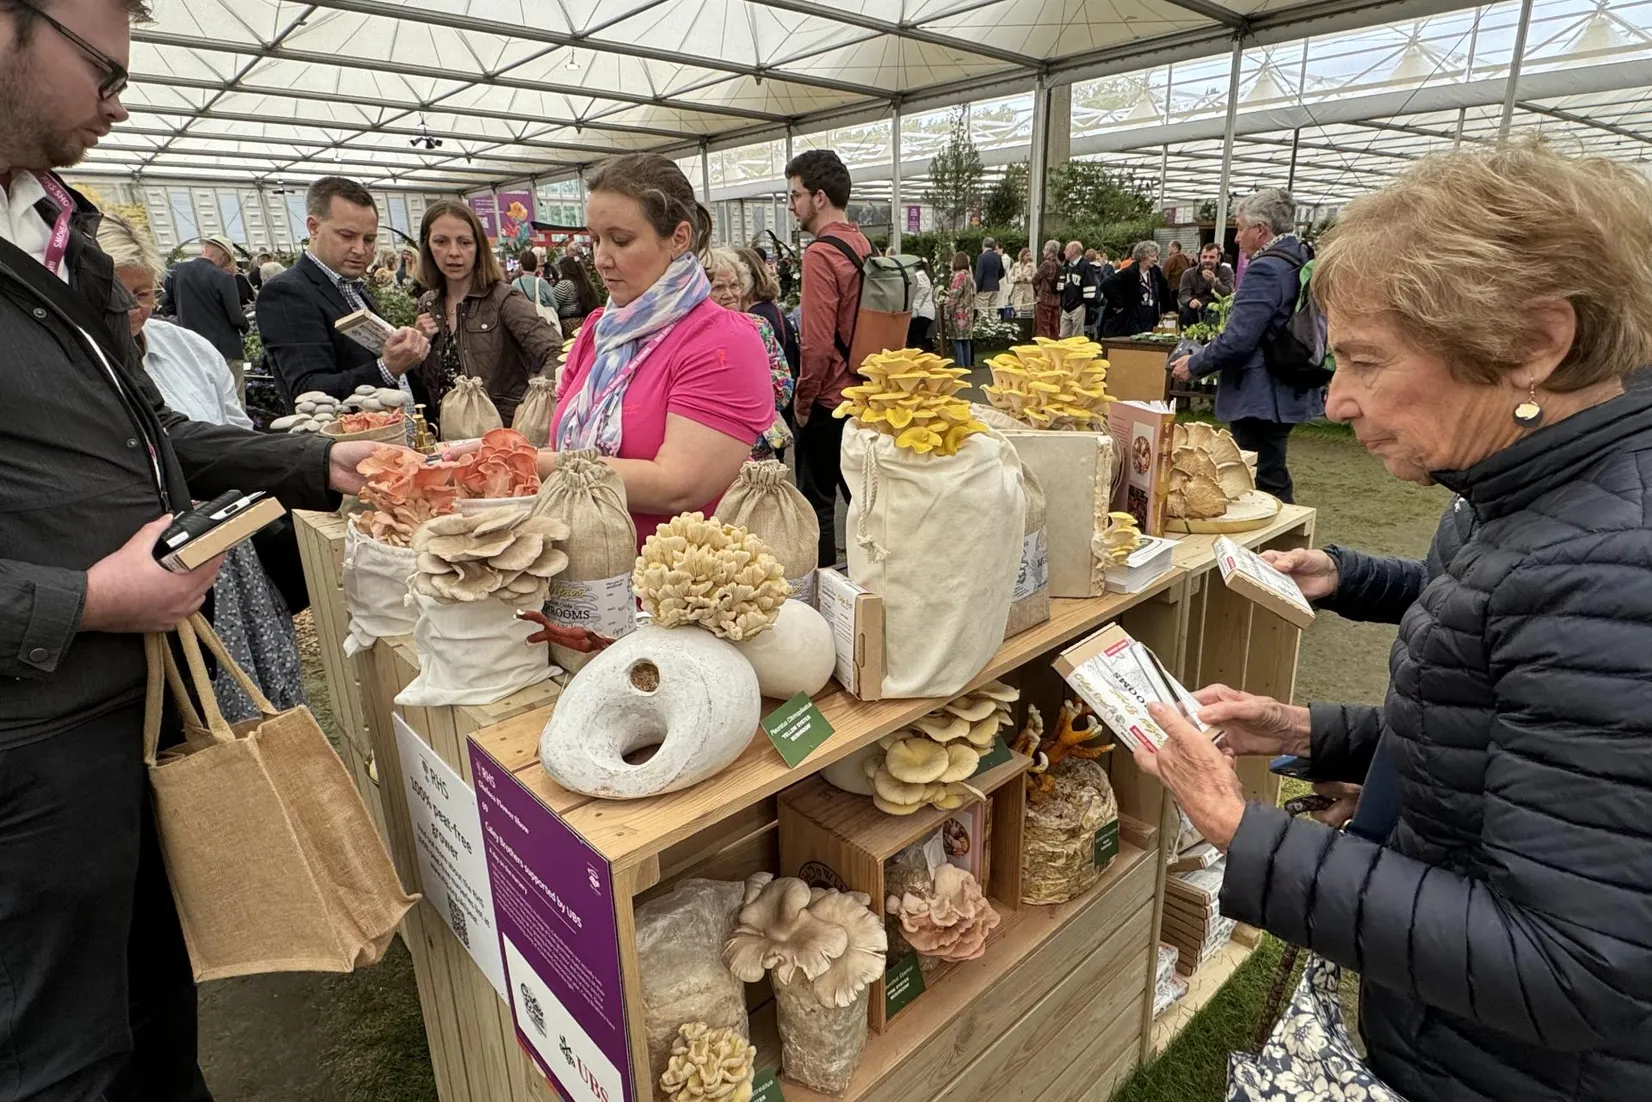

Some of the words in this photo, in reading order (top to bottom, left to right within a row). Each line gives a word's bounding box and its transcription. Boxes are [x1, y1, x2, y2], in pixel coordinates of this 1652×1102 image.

[430, 768, 449, 800] RHS
[410, 776, 432, 810] 100%
[432, 804, 472, 855] peat-free
[431, 822, 458, 861] grower
[499, 836, 524, 868] Brothers
[523, 865, 557, 903] supported
[556, 895, 566, 913] by
[566, 906, 583, 928] UBS
